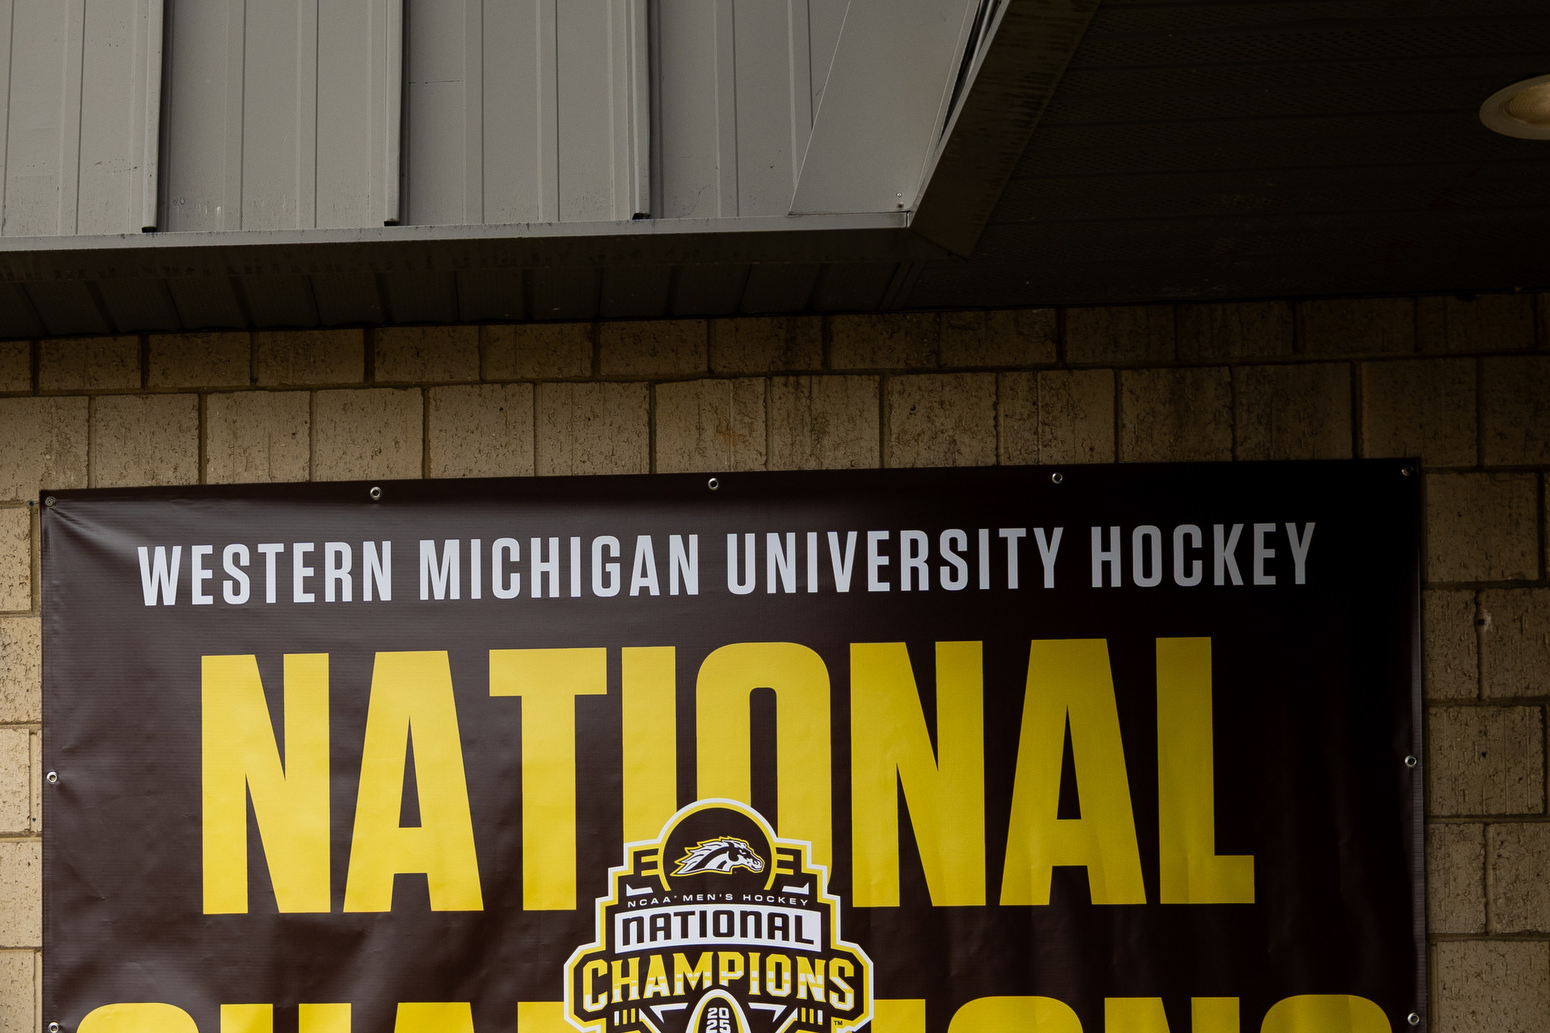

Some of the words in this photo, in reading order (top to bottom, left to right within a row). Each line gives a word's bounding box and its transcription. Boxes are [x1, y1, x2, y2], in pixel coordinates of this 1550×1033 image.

[137, 540, 392, 606] WESTERN
[419, 533, 699, 600] MICHIGAN
[727, 527, 1064, 595] UNIVERSITY
[1091, 521, 1316, 588] HOCKEY
[201, 636, 1255, 916] NATIONAL
[683, 893, 733, 902] MEN'S
[743, 894, 809, 906] HOCKEY
[622, 909, 815, 946] NATIONAL
[582, 951, 855, 1012] CHAMPIONS
[707, 1007, 730, 1019] 20
